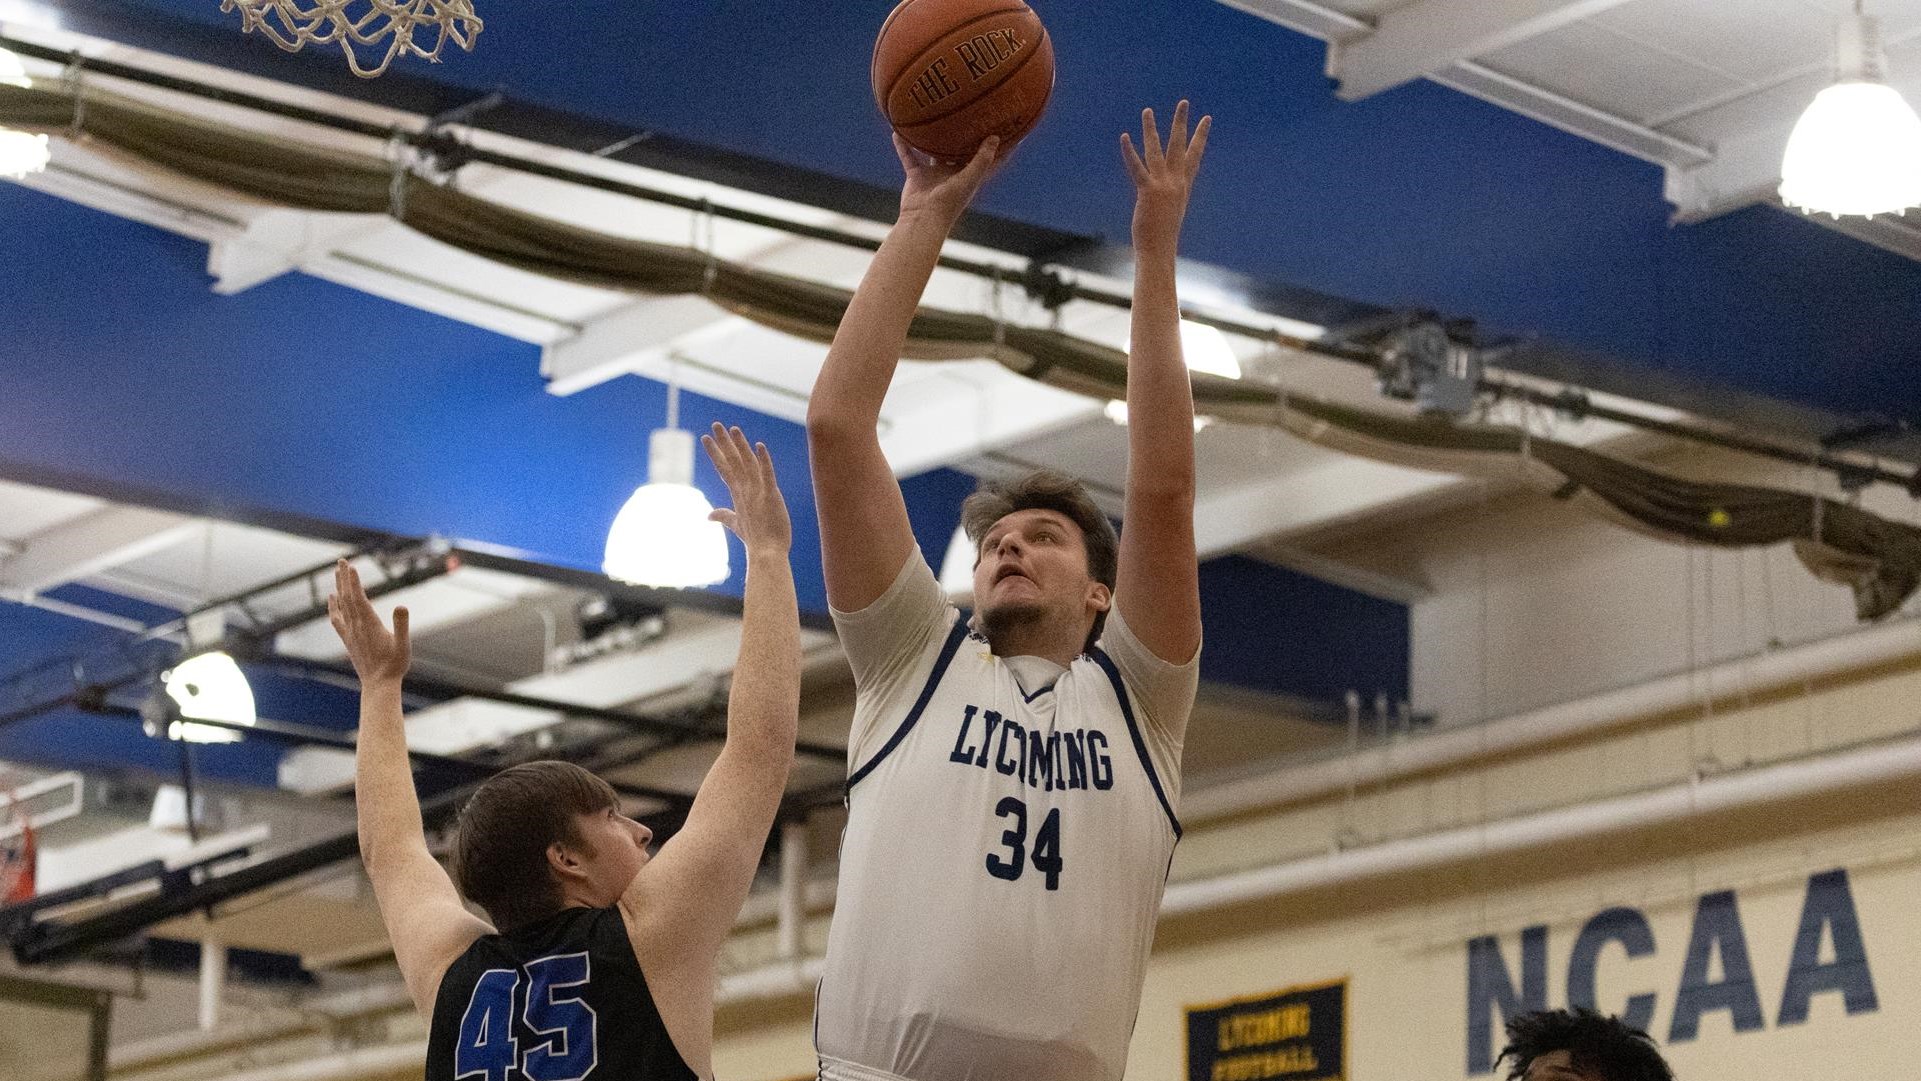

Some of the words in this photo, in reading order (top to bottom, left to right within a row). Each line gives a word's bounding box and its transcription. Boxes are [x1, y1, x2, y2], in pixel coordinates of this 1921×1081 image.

[908, 56, 960, 110] THE
[954, 28, 1023, 81] ROCK
[986, 796, 1063, 891] 34
[455, 950, 598, 1081] 45
[1466, 867, 1880, 1078] NCAA
